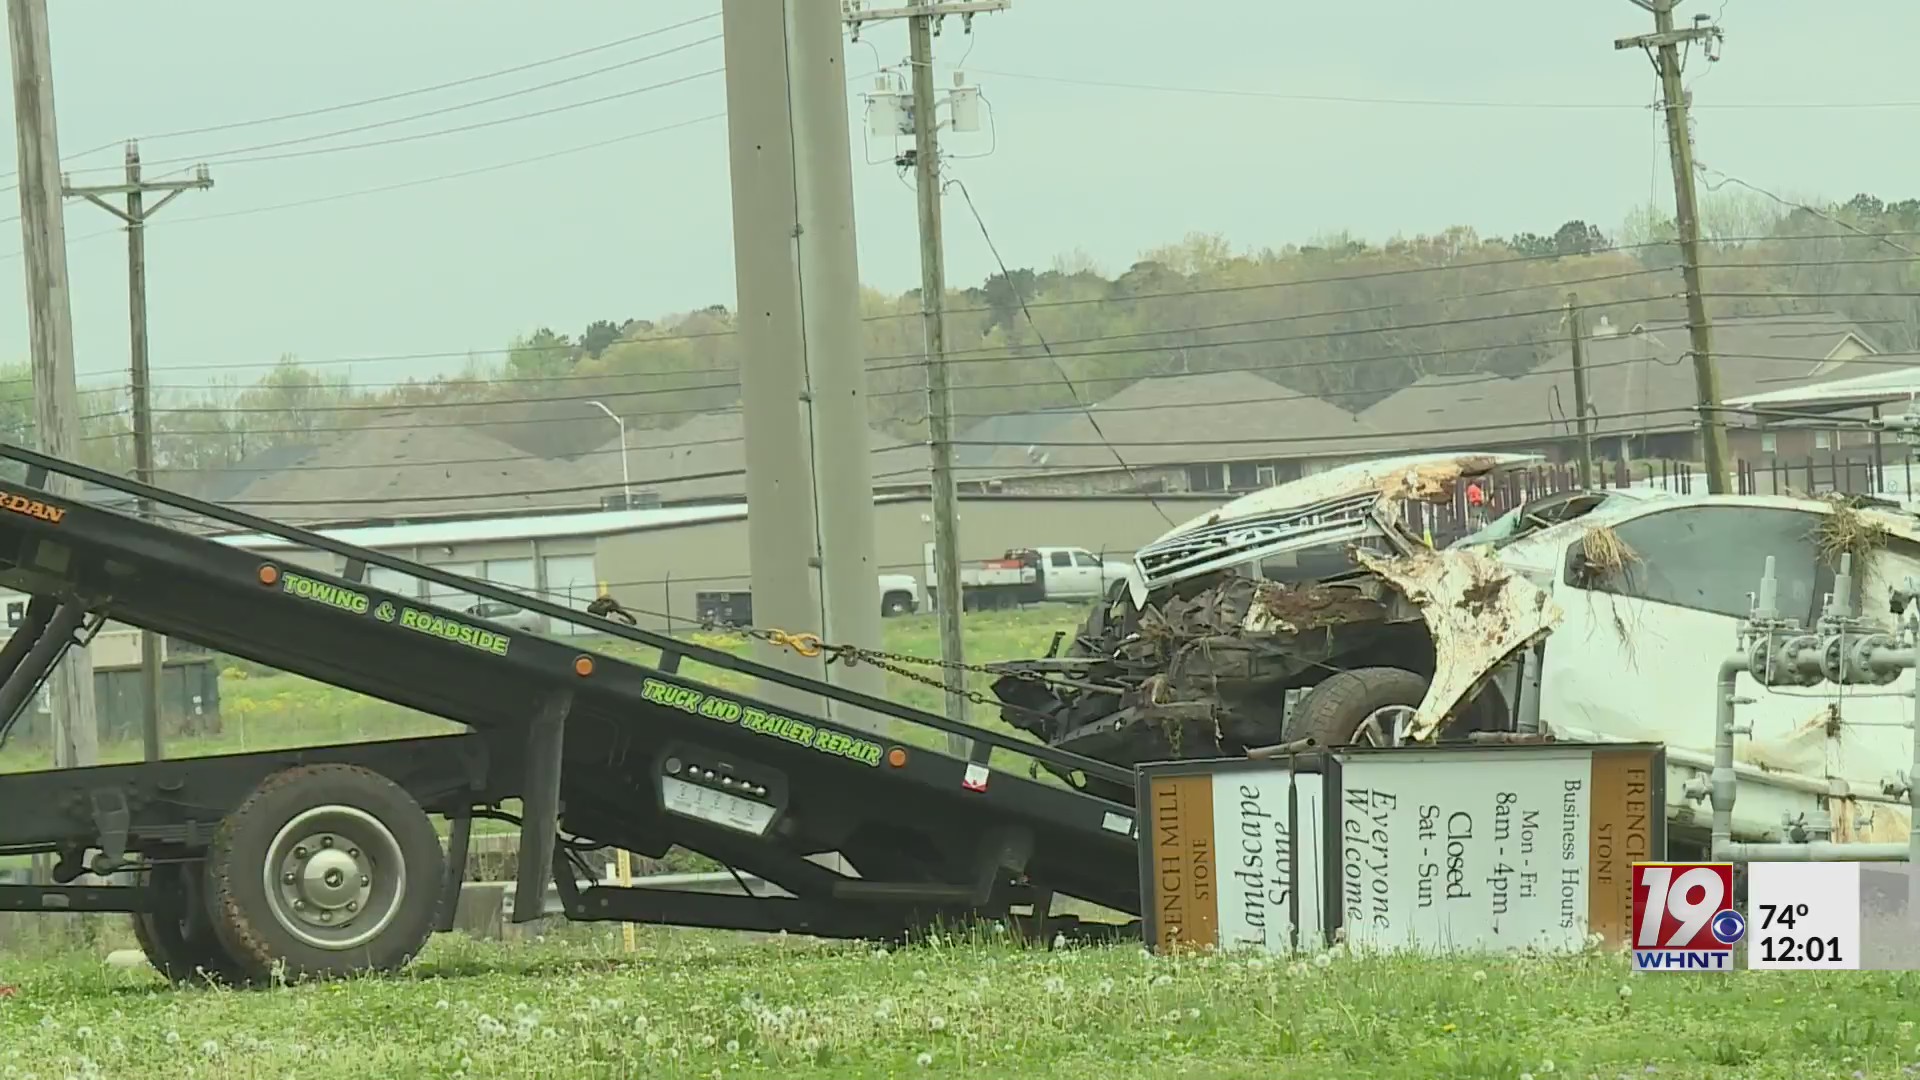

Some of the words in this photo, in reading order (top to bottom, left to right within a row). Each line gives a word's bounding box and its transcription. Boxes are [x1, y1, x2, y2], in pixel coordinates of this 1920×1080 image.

[282, 572, 369, 614] TOWING
[375, 601, 396, 622] &
[400, 608, 510, 656] ROADSIDE
[642, 678, 702, 713] TRUCK
[700, 697, 742, 723] AND
[741, 706, 815, 747] TRAILER
[814, 728, 883, 767] REPAIR
[1158, 785, 1180, 847] MILL
[1418, 804, 1440, 840] Sat
[1494, 792, 1517, 841] 8am
[1520, 809, 1540, 854] Mon
[1562, 779, 1582, 860] Business
[1192, 839, 1209, 900] STONE
[1234, 785, 1271, 947] Landscape
[1344, 788, 1369, 921] Welcome
[1365, 788, 1397, 929] Everyone
[1446, 811, 1473, 900] Closed
[1597, 823, 1613, 885] STONE
[1161, 857, 1184, 954] RENCH
[1418, 863, 1439, 908] Sun
[1486, 862, 1515, 915] 4pm
[1520, 872, 1538, 899] Fri
[1561, 868, 1580, 928] Hours
